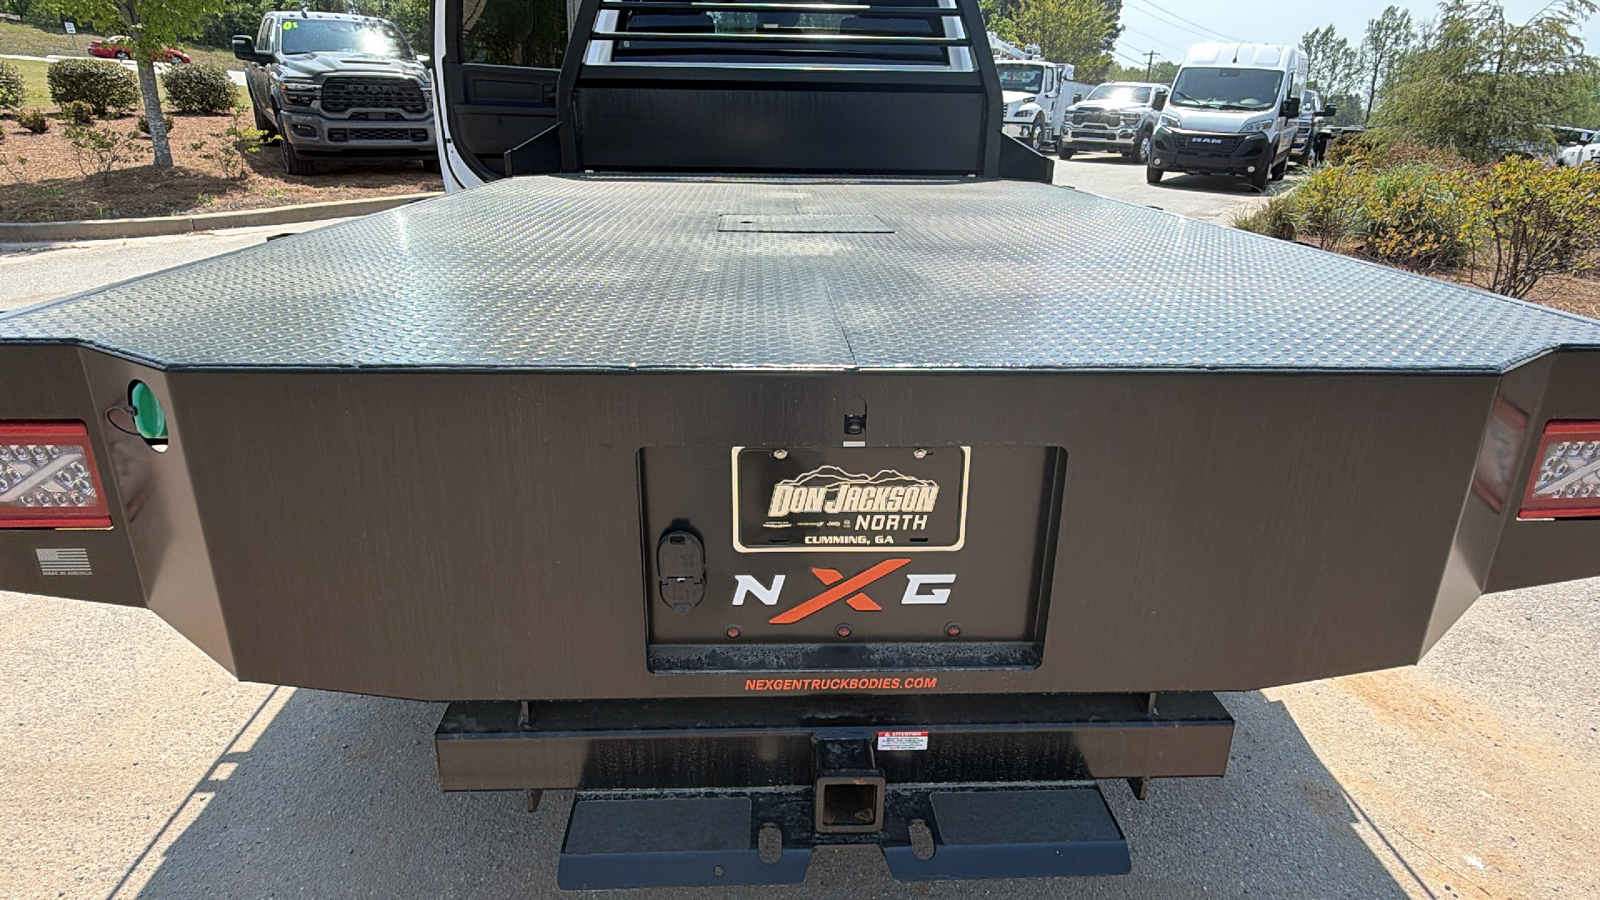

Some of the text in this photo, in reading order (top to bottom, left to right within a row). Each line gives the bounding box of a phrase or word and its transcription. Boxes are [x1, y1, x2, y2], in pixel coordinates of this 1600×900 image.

[855, 515, 928, 531] NORTH
[804, 536, 895, 546] CUMMING, GA
[744, 677, 938, 692] NEXGENTRUCKBODIES.COM
